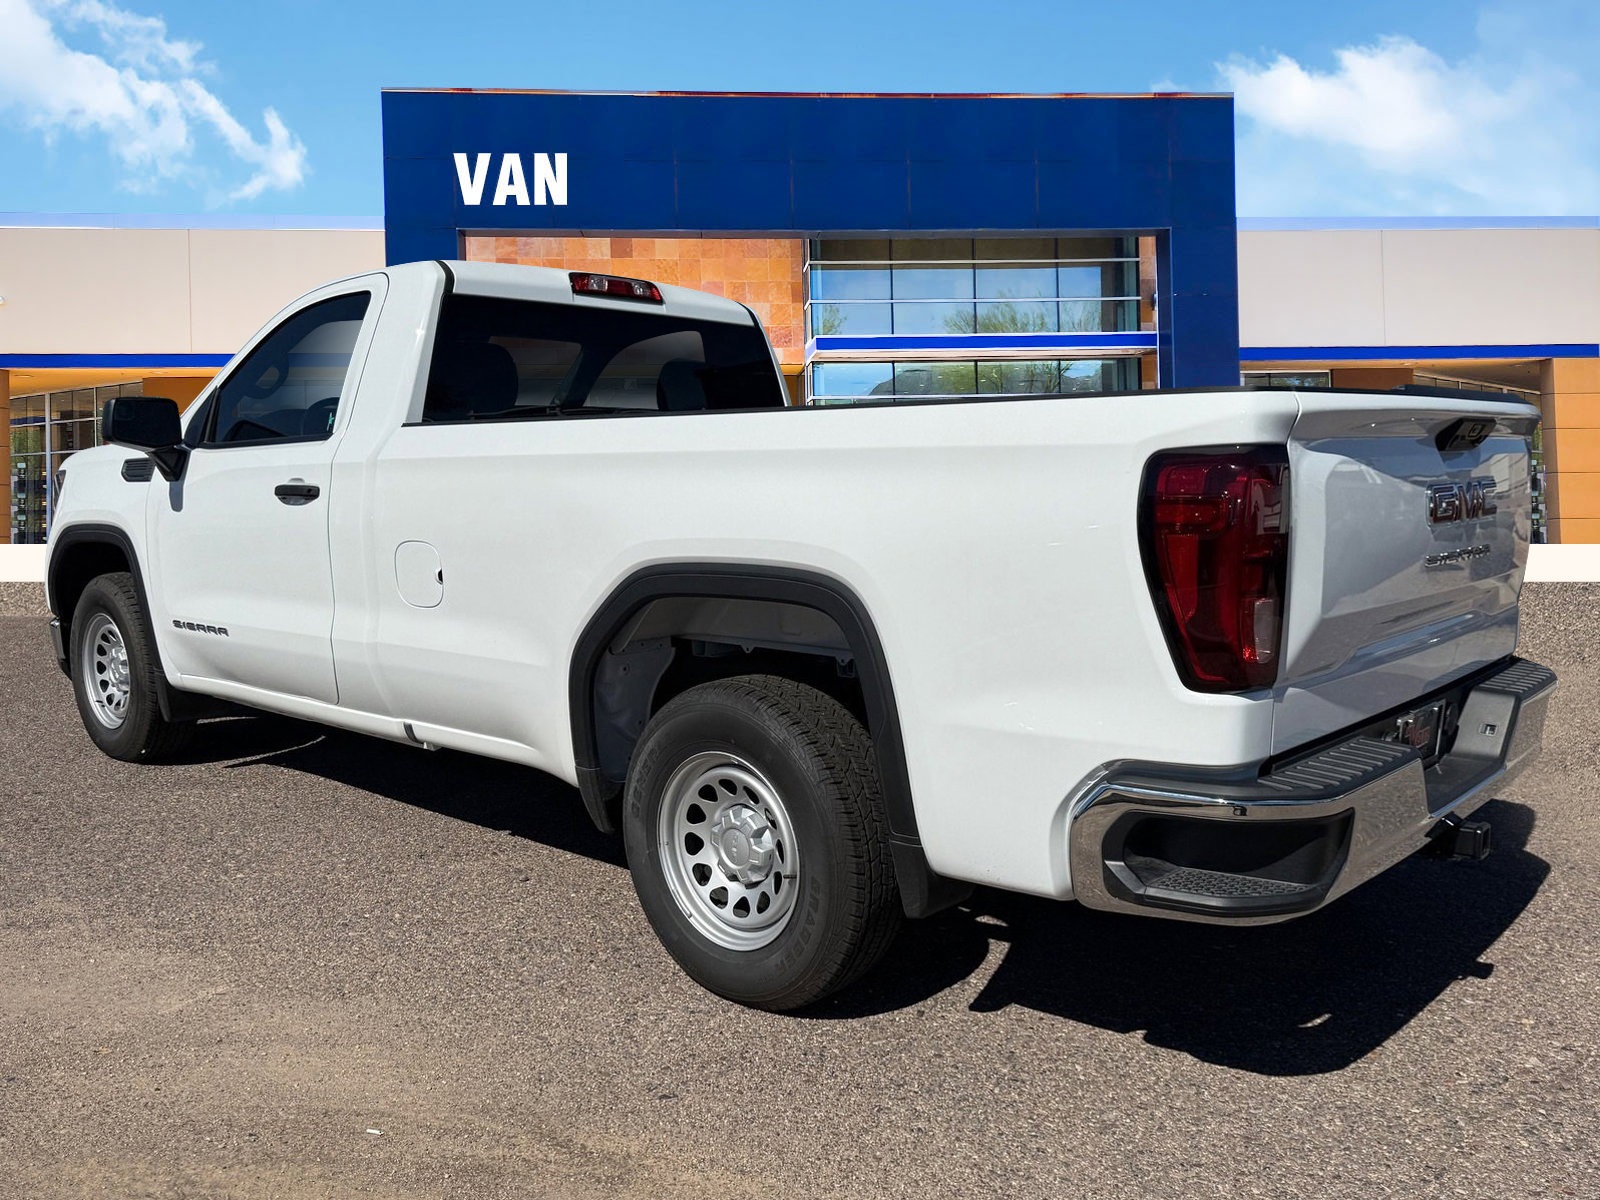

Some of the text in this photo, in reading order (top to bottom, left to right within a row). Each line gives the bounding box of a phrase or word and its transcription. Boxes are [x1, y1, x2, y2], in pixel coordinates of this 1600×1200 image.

[453, 153, 568, 206] VAN
[1425, 476, 1497, 524] GMC
[1424, 544, 1491, 567] SIERRA
[172, 619, 230, 637] SIERRA
